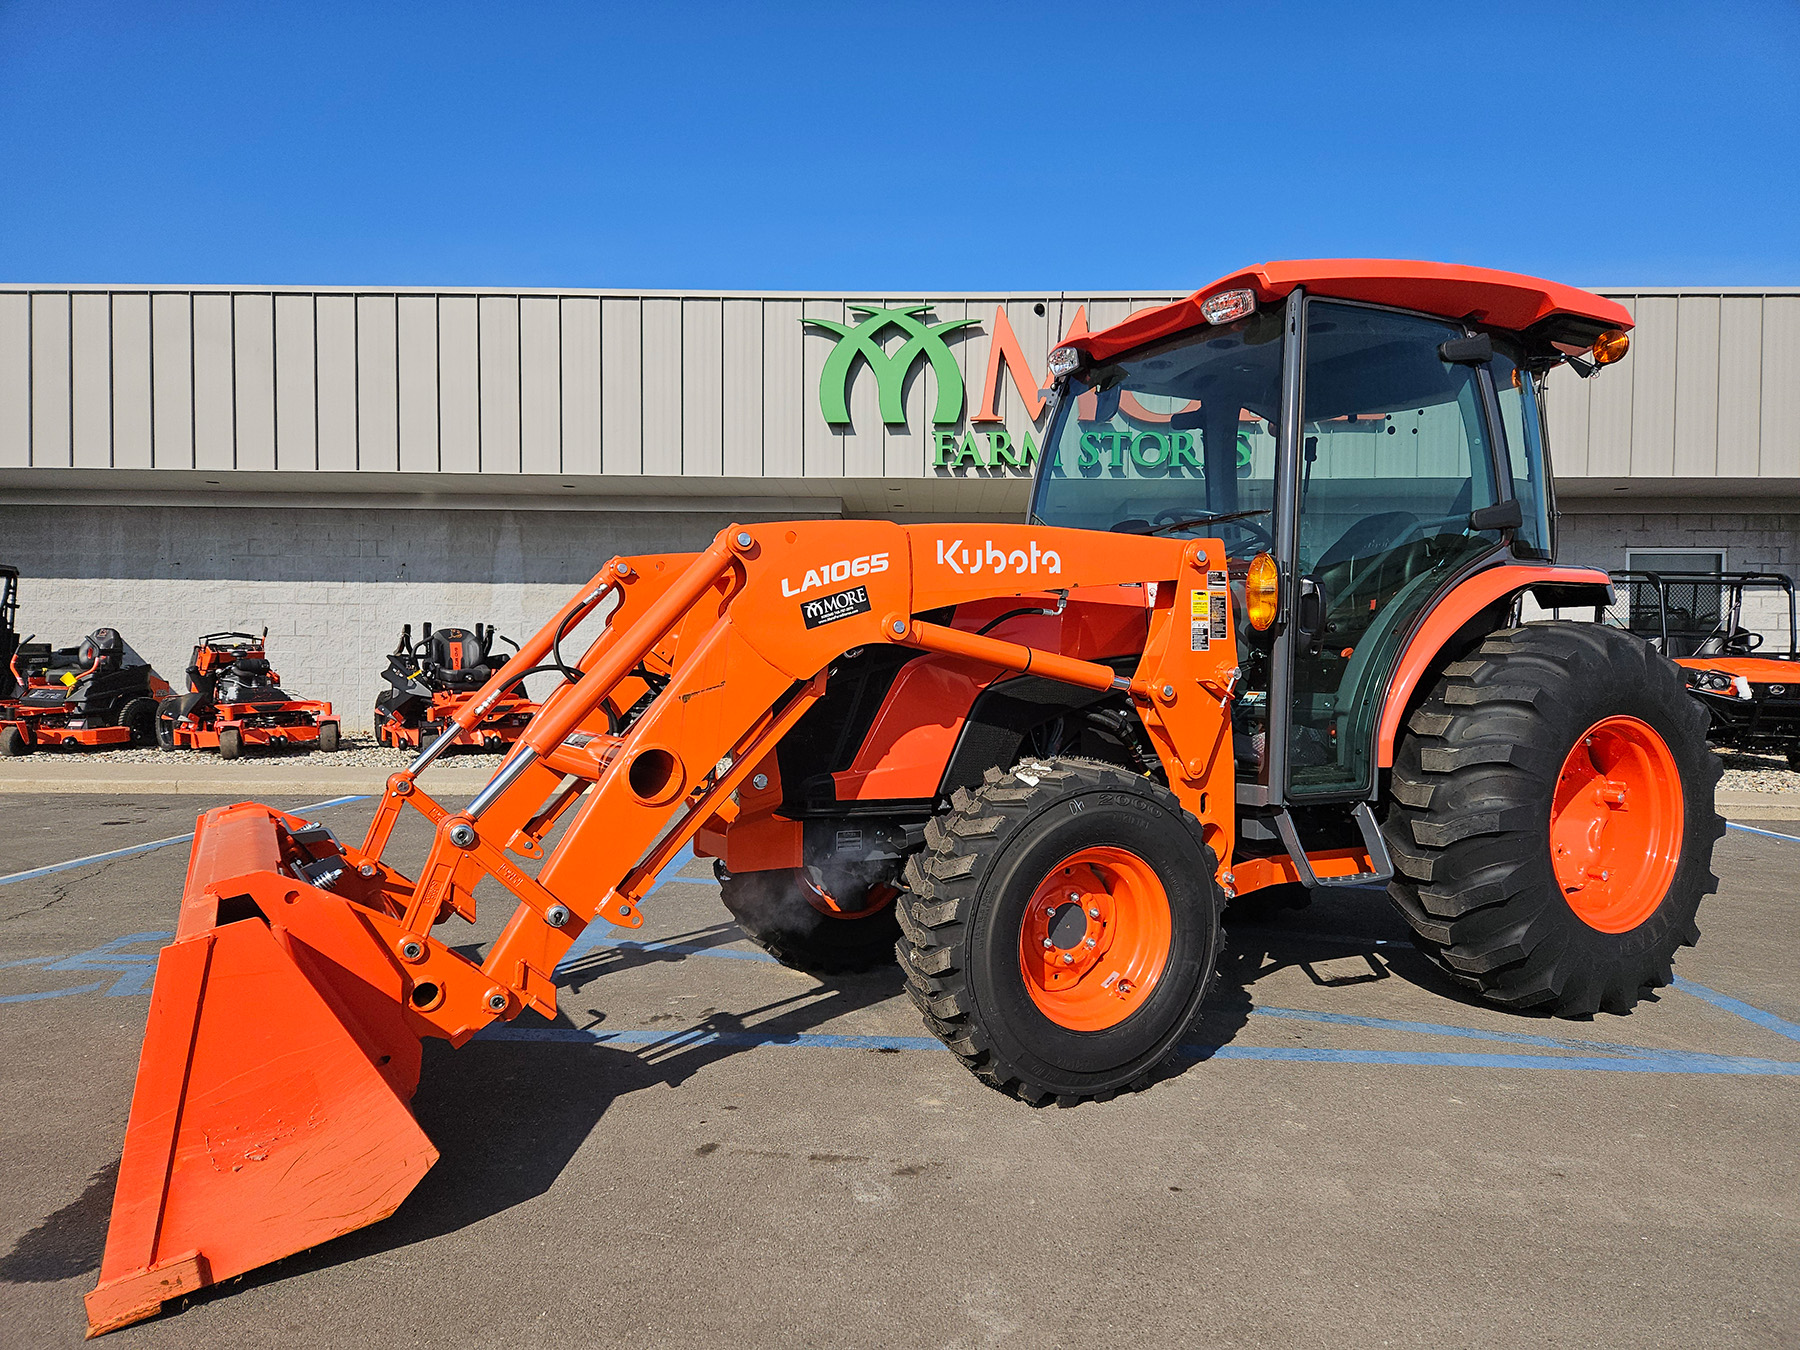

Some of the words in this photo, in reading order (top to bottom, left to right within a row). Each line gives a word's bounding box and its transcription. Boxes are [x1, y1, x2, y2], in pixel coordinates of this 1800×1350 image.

[1078, 430, 1251, 468] STORS
[936, 539, 1062, 574] Kubota
[781, 552, 889, 598] LA1065
[823, 588, 867, 614] MORE
[1098, 793, 1163, 819] 2000
